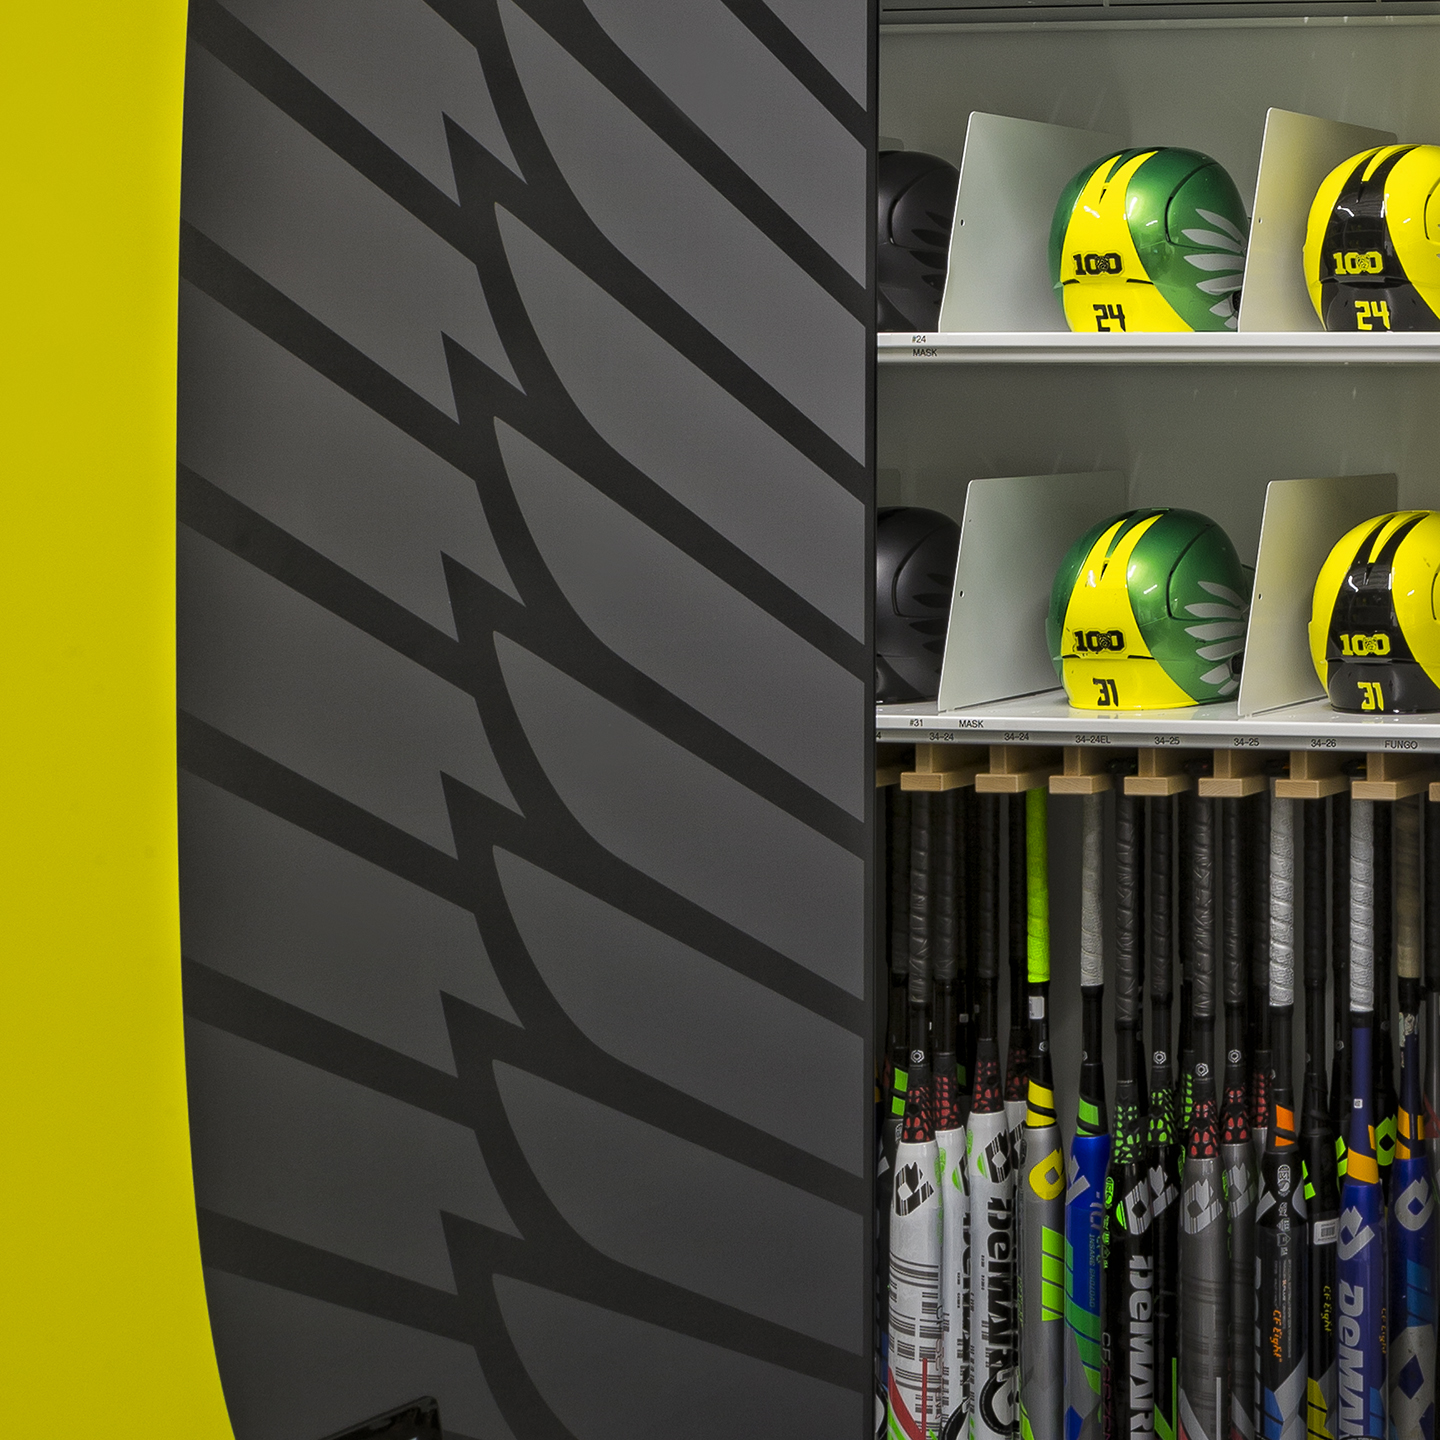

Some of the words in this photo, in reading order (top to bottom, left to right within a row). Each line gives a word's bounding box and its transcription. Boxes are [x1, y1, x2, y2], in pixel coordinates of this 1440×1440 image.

[1073, 253, 1122, 275] 100
[1332, 252, 1383, 274] 100
[1095, 304, 1125, 332] 24
[1355, 300, 1389, 329] 24
[912, 349, 938, 357] MASK
[1073, 629, 1124, 652] 100
[1340, 633, 1390, 656] 100
[1093, 678, 1119, 707] 31
[1357, 681, 1384, 711] 31
[909, 718, 924, 727] #31
[958, 720, 984, 729] MASK
[929, 732, 954, 741] 34-24
[1004, 732, 1029, 741] 34-24
[1075, 735, 1111, 744] 34-24EL
[1154, 736, 1180, 746] 34-25
[1233, 737, 1260, 747] 34-25
[1310, 739, 1337, 748] 34-26
[1384, 740, 1418, 749] FUNGO
